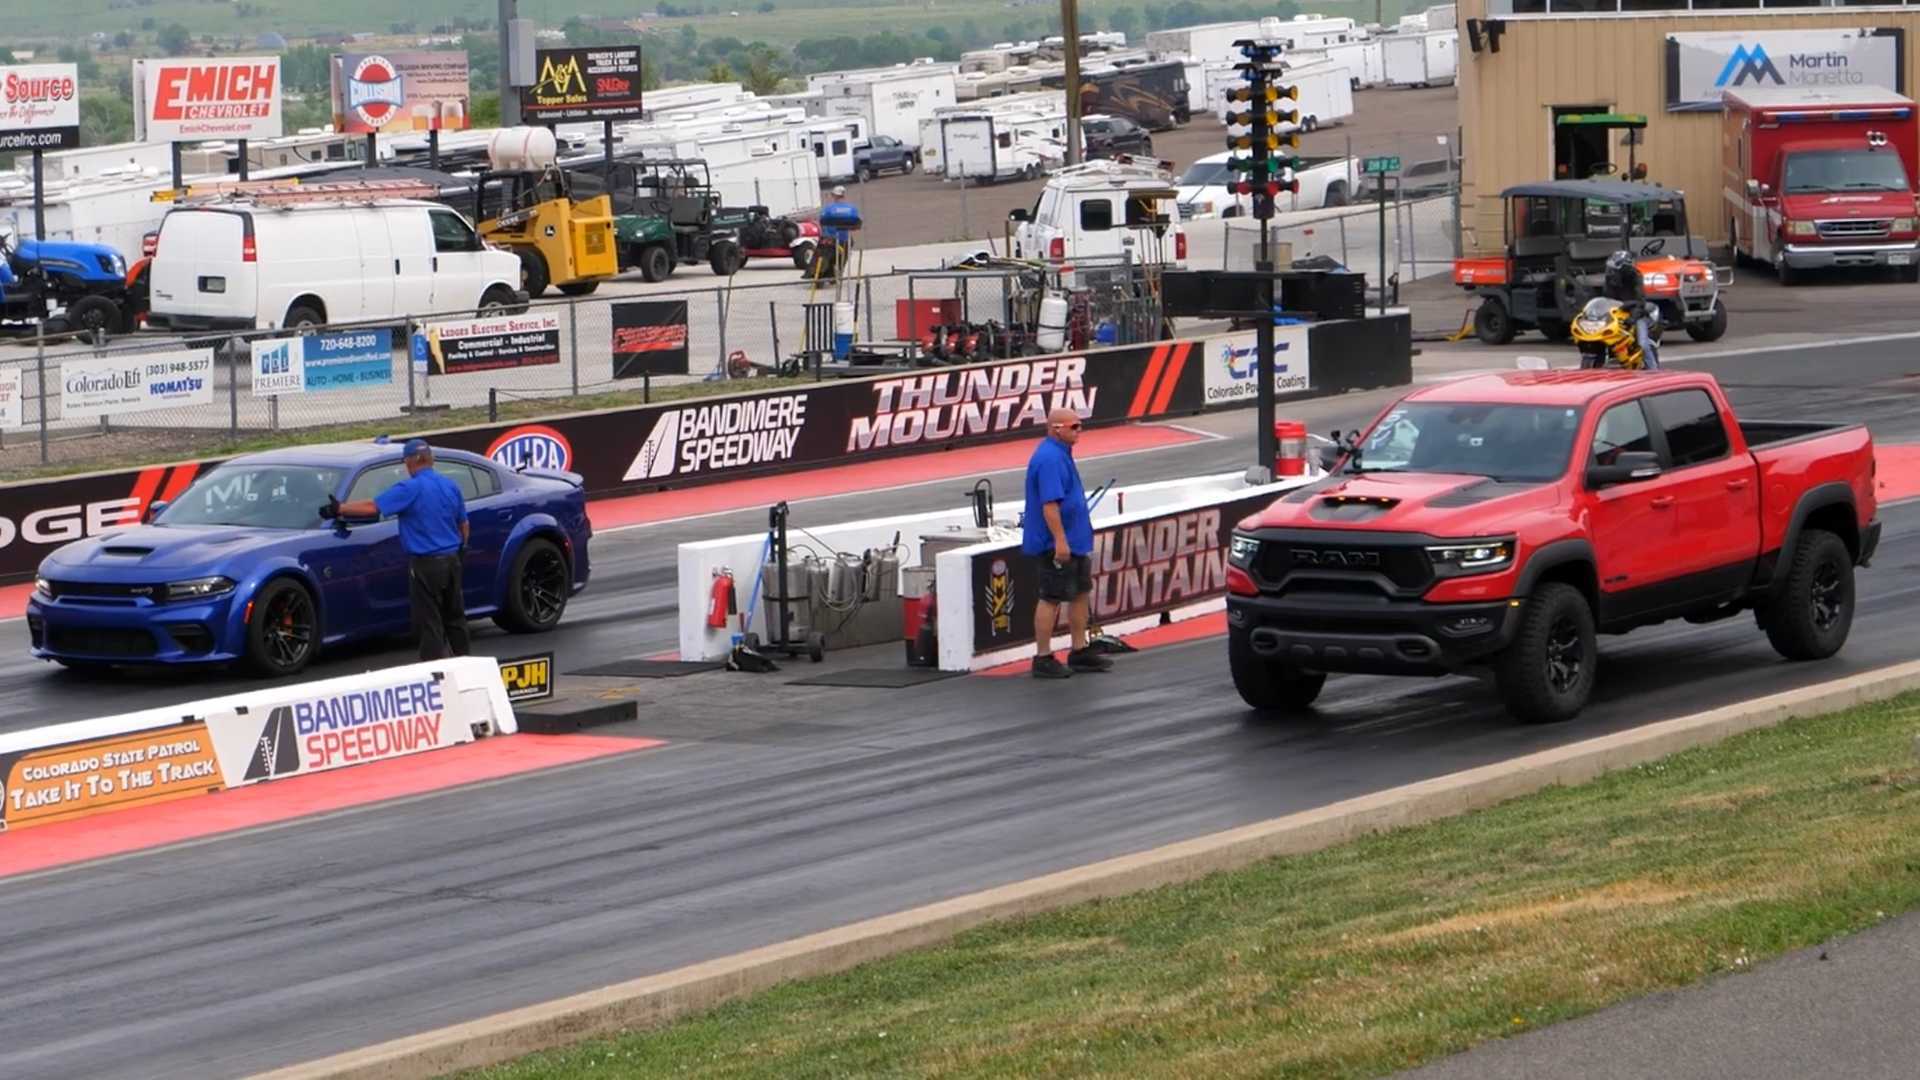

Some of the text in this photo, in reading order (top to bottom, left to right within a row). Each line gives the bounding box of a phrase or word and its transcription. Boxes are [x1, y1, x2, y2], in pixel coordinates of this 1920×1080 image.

[1790, 51, 1848, 68] Martin
[6, 74, 75, 104] Source
[153, 65, 276, 120] EMICH
[189, 104, 265, 118] CHEVROLET
[458, 338, 504, 350] Commercial
[511, 333, 545, 345] Industrial
[471, 322, 506, 334] ELECTRIC
[146, 363, 169, 378] (303)
[150, 376, 203, 395] KOMATSU
[1276, 375, 1307, 390] Coating
[872, 357, 1087, 416] THUNDER
[1207, 384, 1245, 399] Colorado
[679, 394, 808, 437] BANDIMERE
[846, 386, 1098, 453] MOUNTAIN
[679, 426, 801, 473] SPEEDWAY
[1091, 509, 1221, 574] UNDER
[1288, 548, 1380, 566] RAM
[501, 661, 546, 690] PJH
[294, 680, 444, 736] BANDIMERE
[306, 713, 442, 769] SPEEDWAY
[22, 739, 200, 782] COLORADO STATE PATROL
[10, 759, 215, 811] TAKE IT TO THE TRACK
